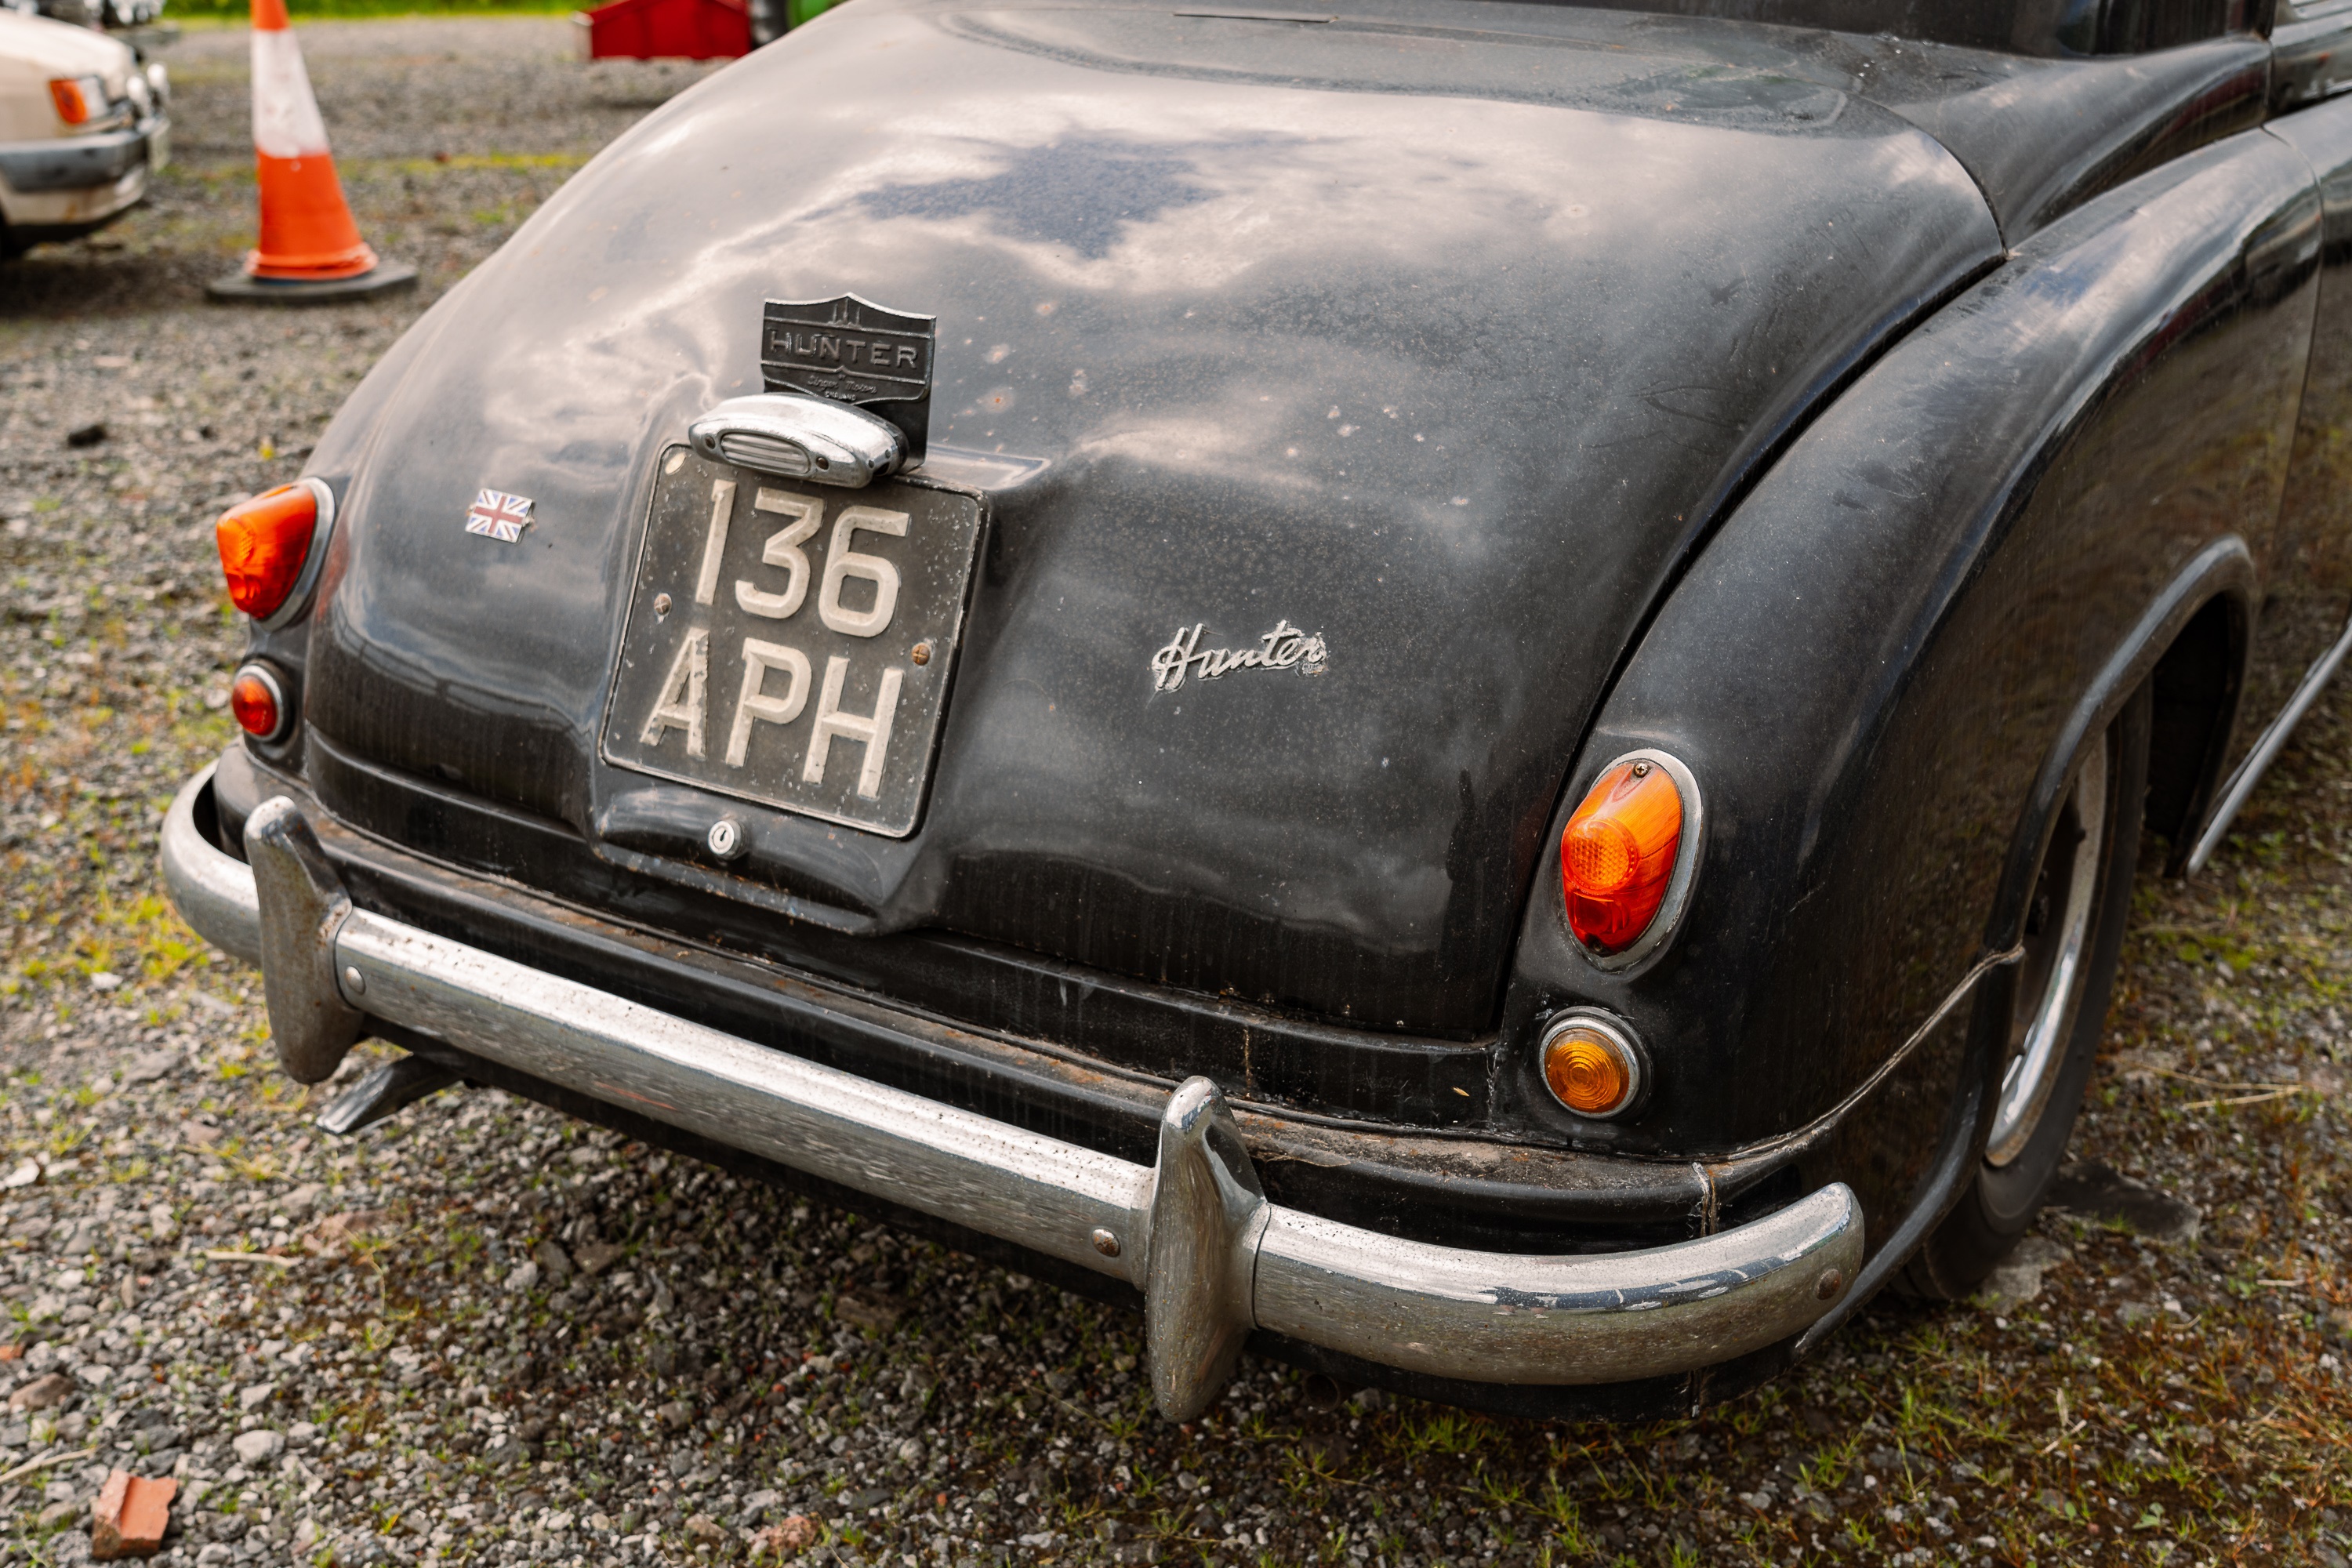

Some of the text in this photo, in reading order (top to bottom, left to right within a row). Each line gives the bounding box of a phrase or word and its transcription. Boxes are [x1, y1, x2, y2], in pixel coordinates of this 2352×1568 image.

[768, 328, 917, 368] HUNTER
[846, 380, 877, 394] Motors
[695, 479, 909, 637] 136
[1152, 619, 1327, 691] Hunter
[640, 627, 903, 799] APH
